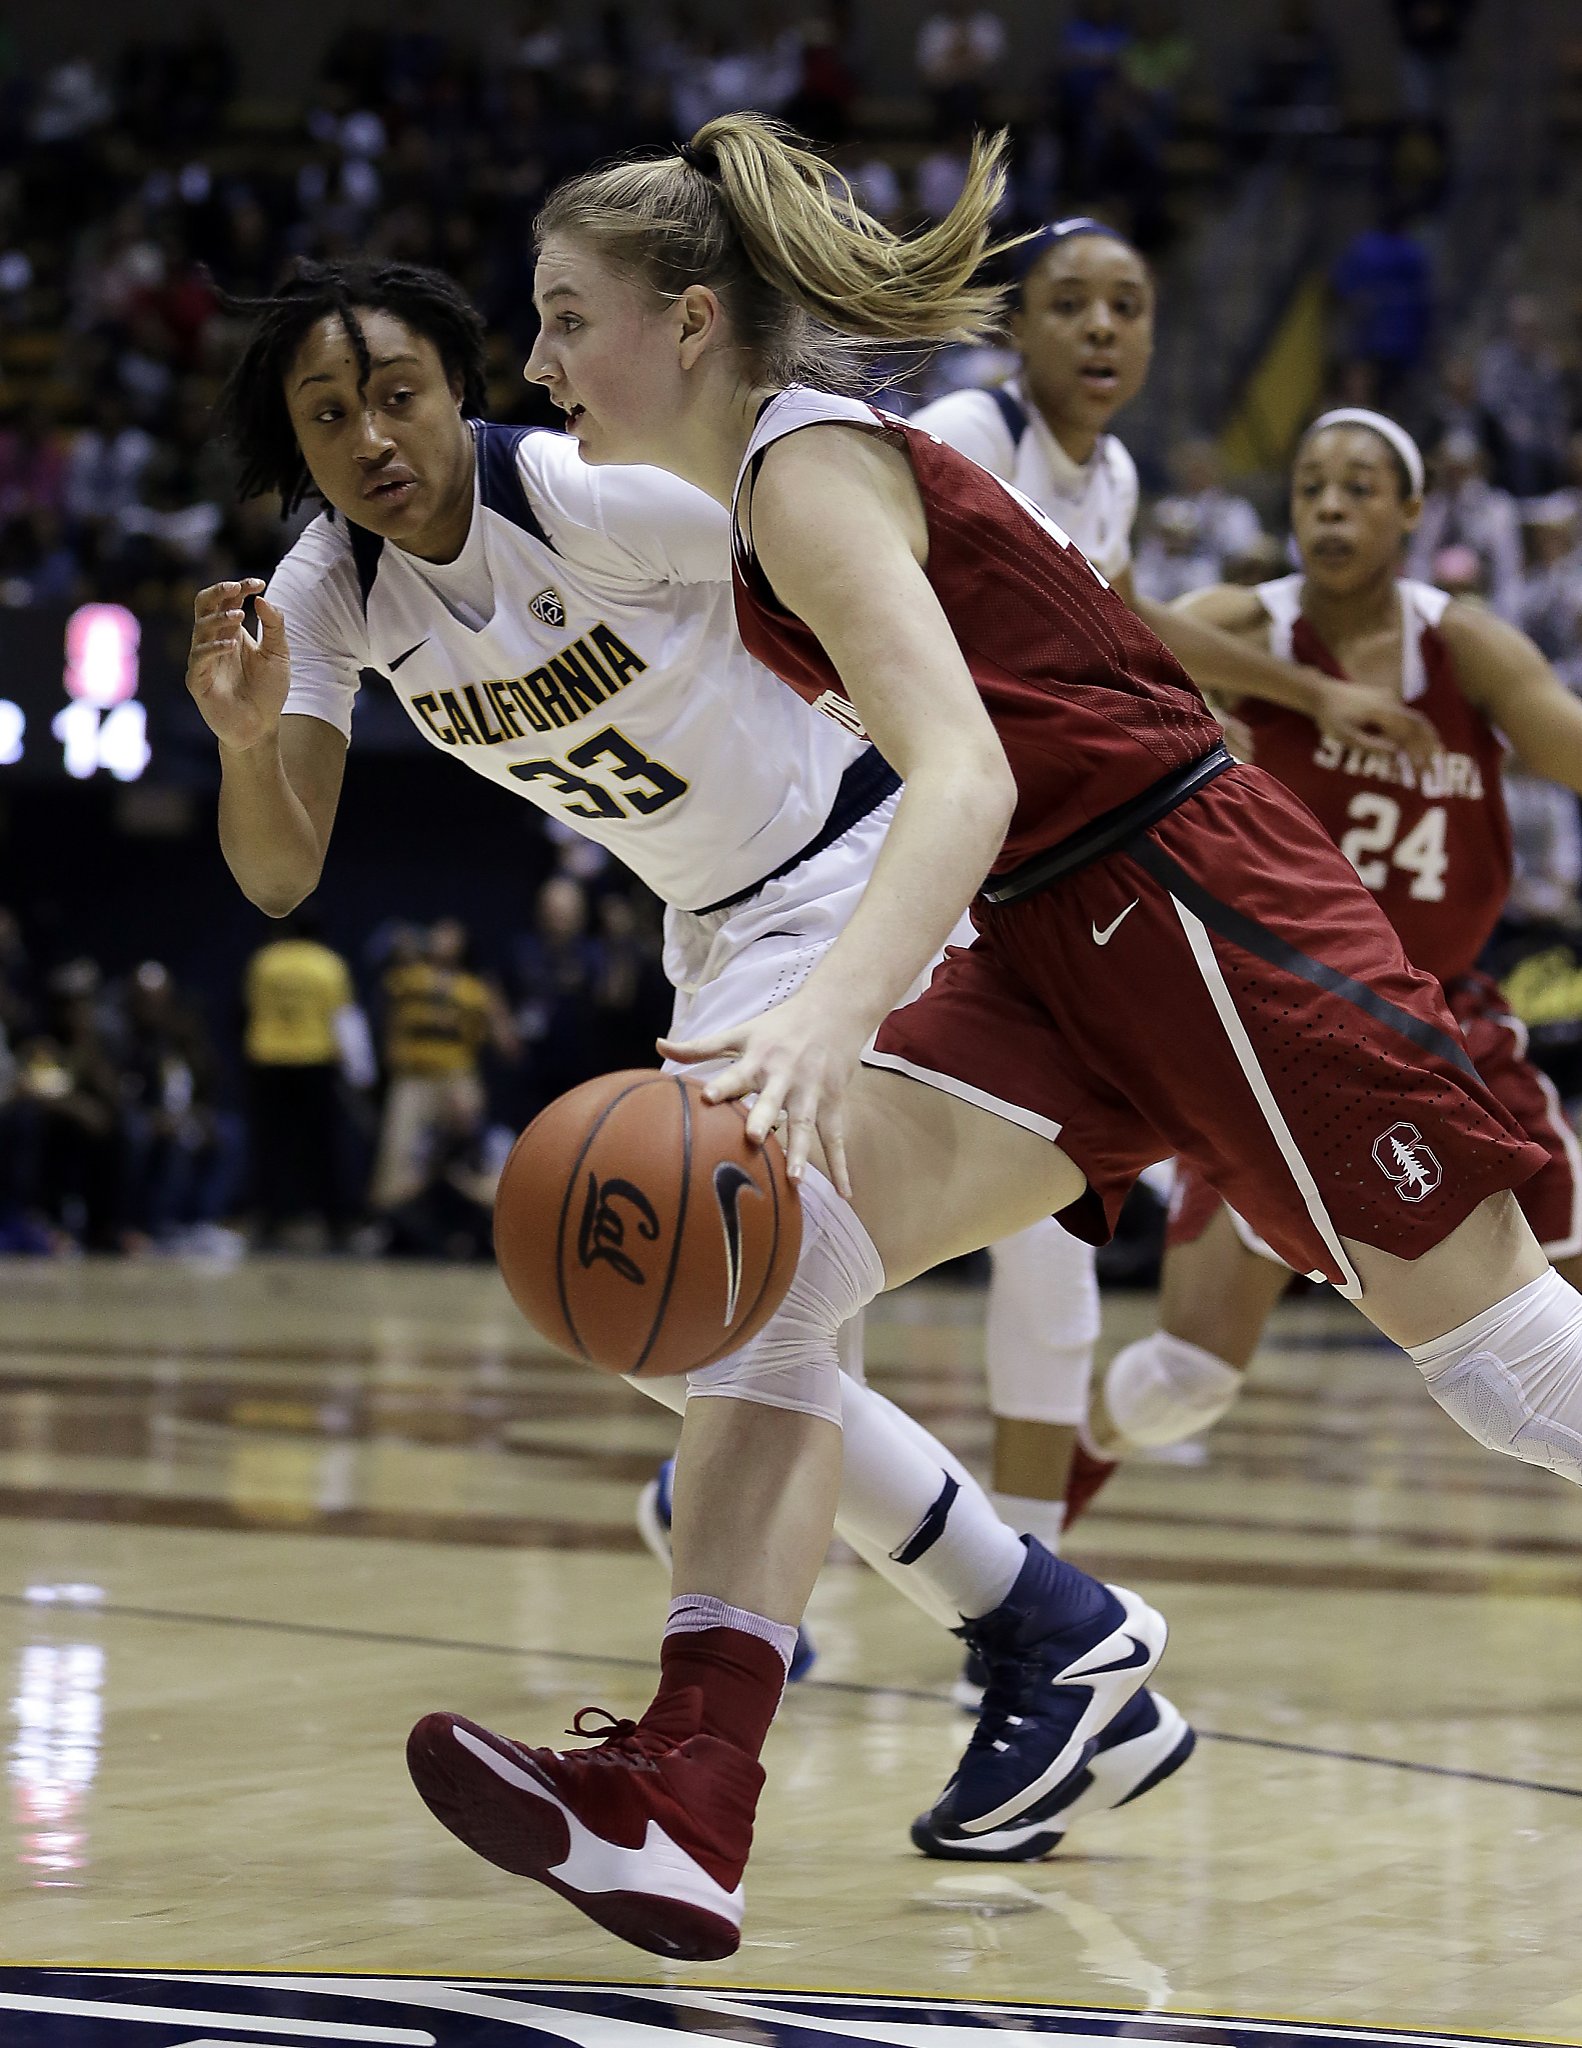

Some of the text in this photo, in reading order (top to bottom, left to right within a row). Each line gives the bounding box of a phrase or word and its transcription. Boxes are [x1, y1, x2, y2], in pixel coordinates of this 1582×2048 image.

[411, 620, 648, 745] CALIFORNIA
[52, 700, 152, 782] 14
[507, 724, 689, 819] 33
[1340, 790, 1449, 902] 24
[577, 1171, 661, 1286] Cal
